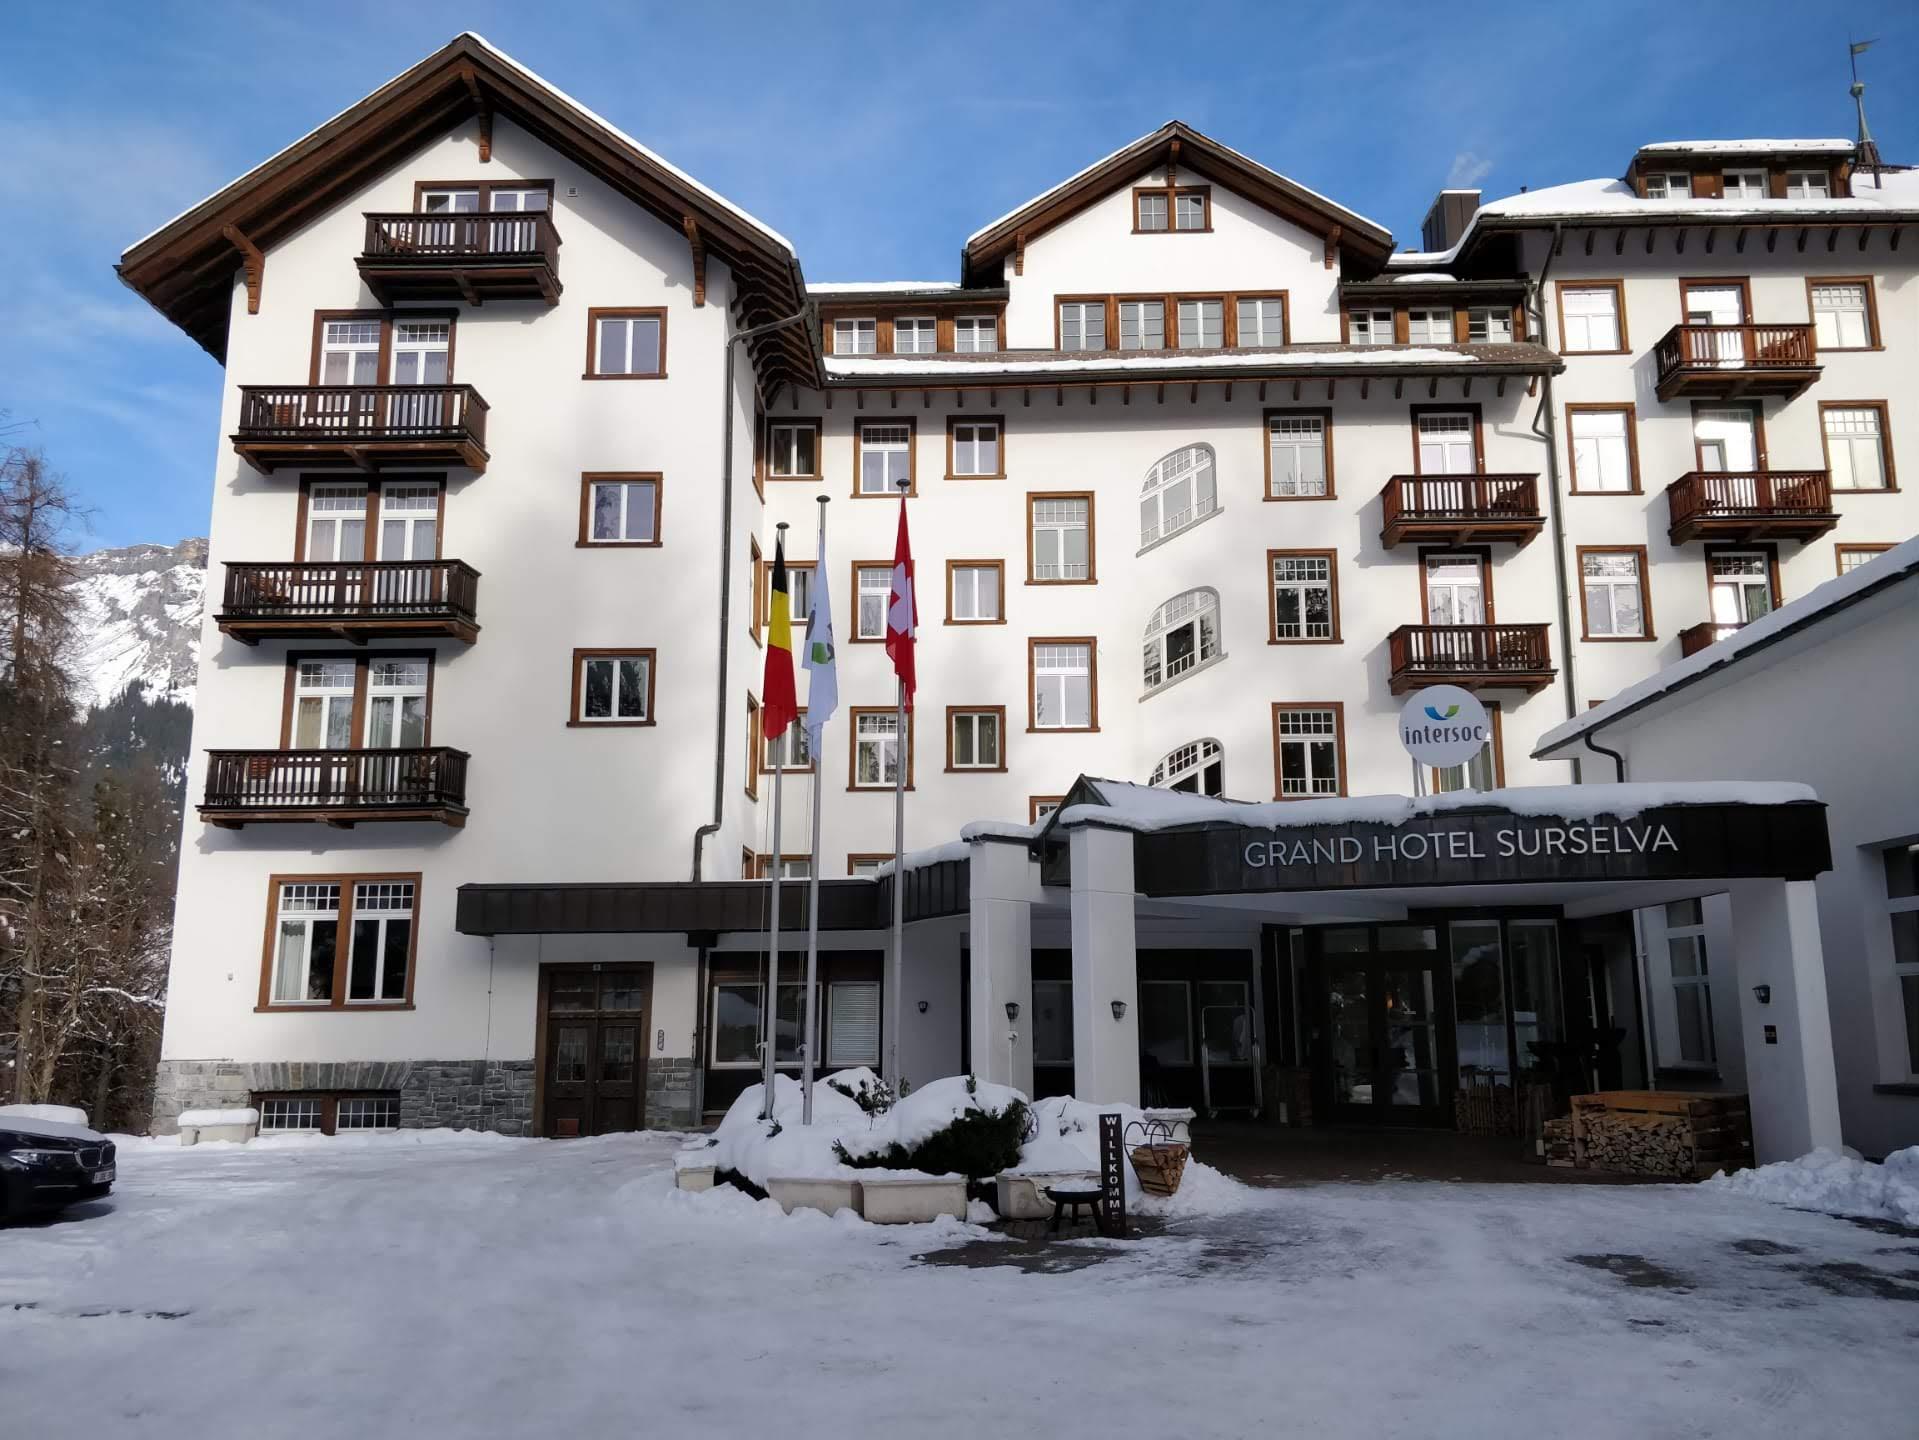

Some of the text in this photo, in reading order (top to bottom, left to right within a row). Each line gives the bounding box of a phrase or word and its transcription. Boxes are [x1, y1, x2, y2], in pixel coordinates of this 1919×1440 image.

[1405, 725, 1483, 745] intersoc
[1244, 824, 1679, 867] GRAND HOTEL SURSELVA
